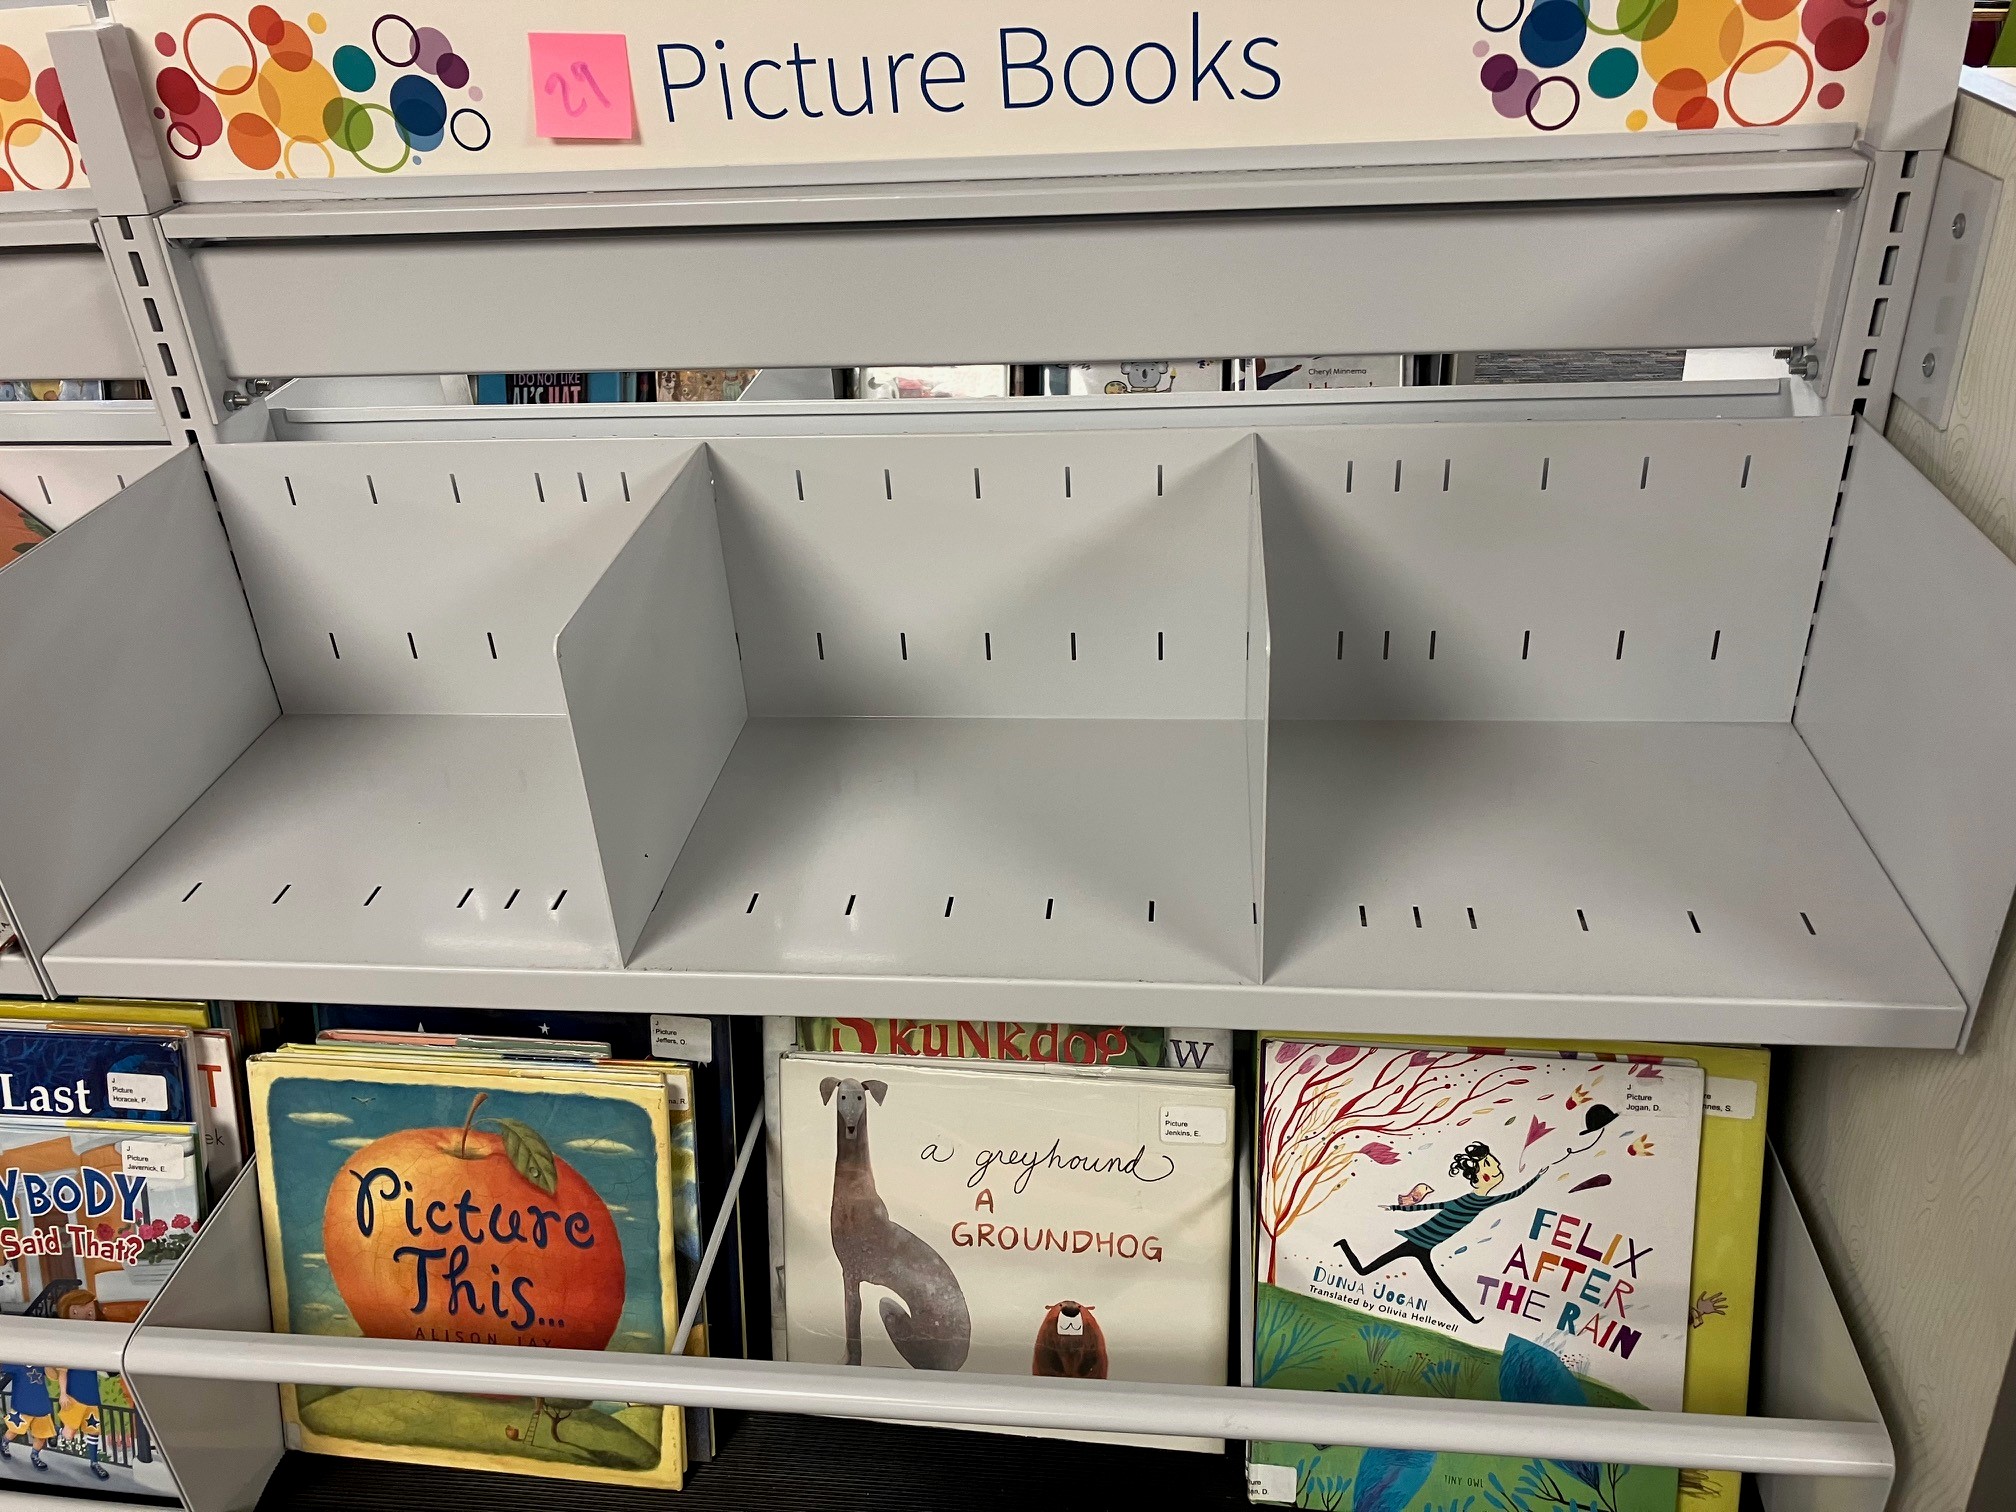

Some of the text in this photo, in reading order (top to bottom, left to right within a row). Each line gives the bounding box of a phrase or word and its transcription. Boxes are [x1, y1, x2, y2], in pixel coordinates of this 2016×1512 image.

[656, 11, 1282, 122] Picture Books
[518, 373, 535, 386] DO
[537, 373, 558, 386] NOT
[560, 373, 581, 385] LIKE
[1308, 368, 1332, 376] Cheryl
[656, 1037, 678, 1045] Jeffers,
[0, 1073, 93, 1115] Last
[112, 1086, 134, 1094] Picture
[198, 1065, 222, 1108] T
[1627, 1093, 1652, 1101] Picture
[1626, 1104, 1651, 1112] Jogan,
[127, 1154, 149, 1163] Picture
[920, 1139, 1175, 1194] a greyhound
[349, 1167, 595, 1249] Picture
[975, 1189, 994, 1214] A
[0, 1225, 145, 1267] Said That?
[951, 1221, 1163, 1263] GROUNDHOG
[1528, 1207, 1654, 1279] FELIX
[393, 1244, 565, 1331] This...
[1313, 1265, 1428, 1312] DUNJA JOGAN
[1502, 1243, 1635, 1319] AFTER
[1309, 1284, 1459, 1333] Translated by Olivia Hellewell
[1476, 1275, 1642, 1360] THE RAIN
[415, 1327, 497, 1344] ALISON
[1444, 1474, 1483, 1488] TINY OWL
